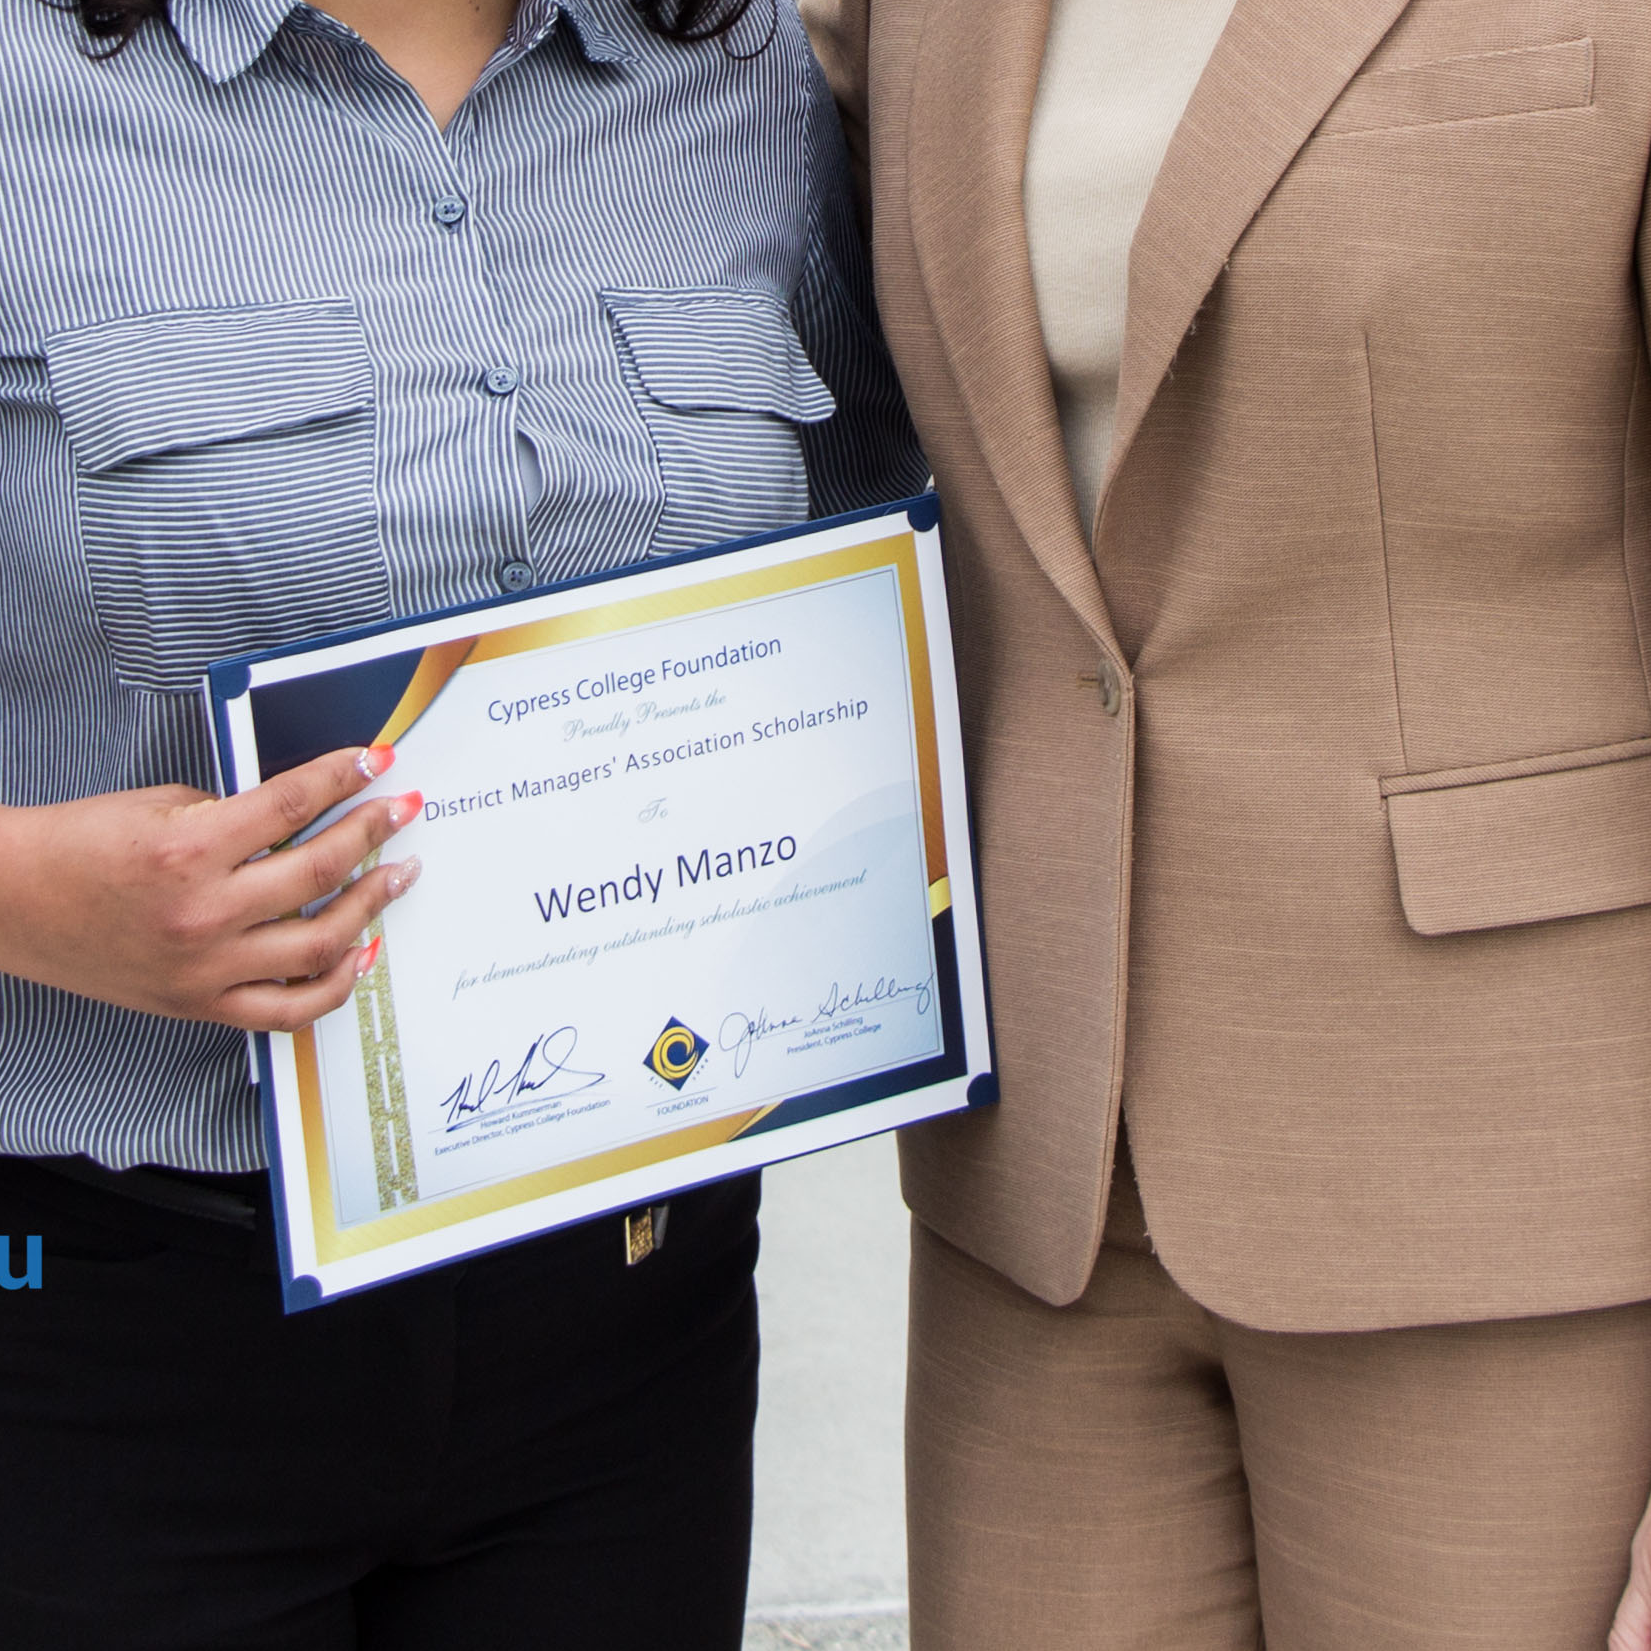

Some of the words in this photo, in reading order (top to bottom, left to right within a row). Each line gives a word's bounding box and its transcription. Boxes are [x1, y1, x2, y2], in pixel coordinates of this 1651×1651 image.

[487, 687, 571, 725] Cypress
[575, 667, 656, 700] College
[661, 637, 782, 681] Foundation
[562, 710, 631, 743] Proudly
[635, 696, 701, 726] Presents
[703, 687, 727, 709] the
[424, 788, 503, 822] District
[510, 755, 617, 801] Managers'
[625, 730, 746, 773] Association
[751, 698, 869, 742] Scholarship
[637, 797, 669, 824] To
[533, 863, 664, 923] Wendy
[676, 834, 797, 888] Manzo
[451, 968, 479, 1001] for
[482, 945, 600, 983] demonstrating
[603, 916, 696, 952] outstanding
[699, 897, 772, 927] scholastic
[773, 868, 868, 908] achievement
[787, 1039, 822, 1054] President,
[824, 1031, 853, 1045] Cypress
[853, 1022, 882, 1036] College
[803, 1026, 831, 1038] JoAnna
[832, 1016, 864, 1031] Schilling
[434, 1138, 471, 1157] Executive
[472, 1126, 504, 1144] Director,
[505, 1121, 535, 1135] Cypress
[535, 1111, 566, 1126] College
[566, 1099, 611, 1117] Foundation
[480, 1114, 511, 1129] Howard
[512, 1100, 563, 1120] Kummerman
[656, 1094, 709, 1116] FOUNDATION
